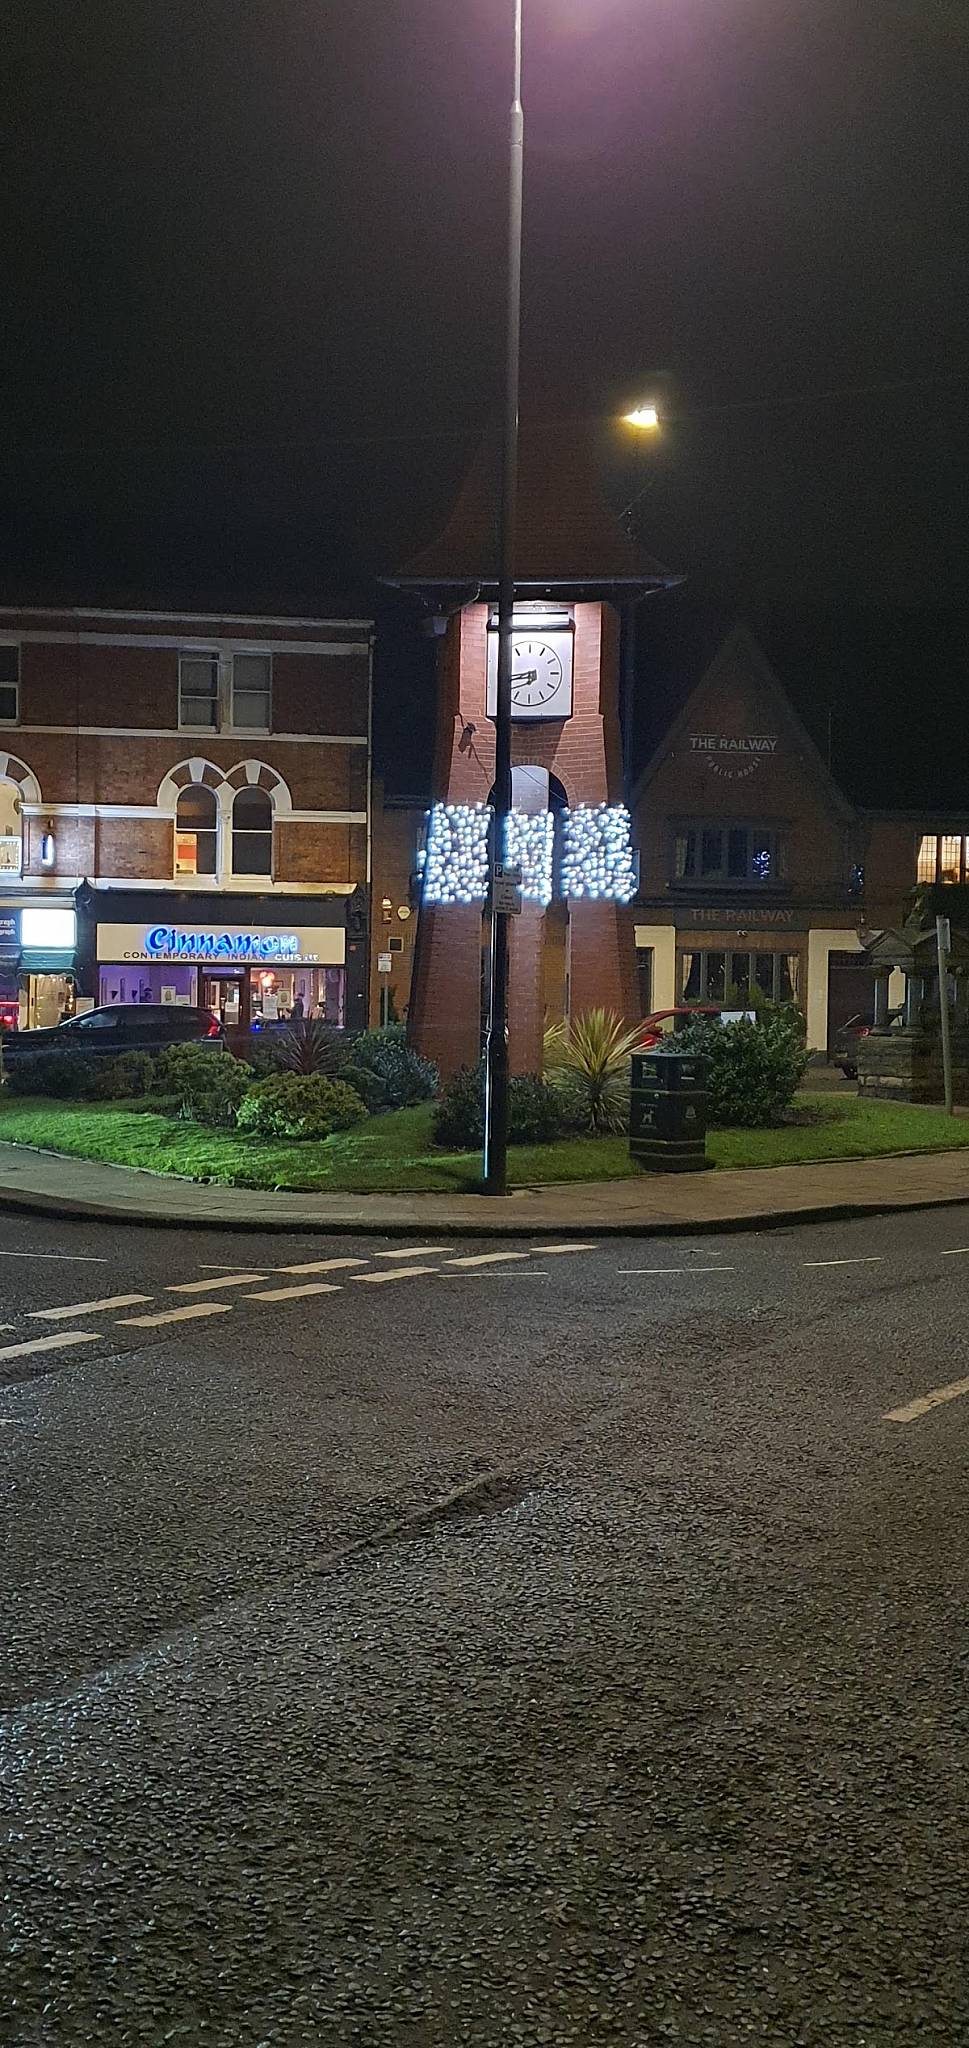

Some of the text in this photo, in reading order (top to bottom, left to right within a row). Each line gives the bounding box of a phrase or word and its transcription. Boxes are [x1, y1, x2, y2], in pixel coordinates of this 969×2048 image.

[690, 737, 777, 751] THE RAILWAY
[689, 908, 794, 922] THE RAILWAY
[145, 926, 298, 954] Cinnamon
[123, 951, 220, 960] CONTEMPORARY
